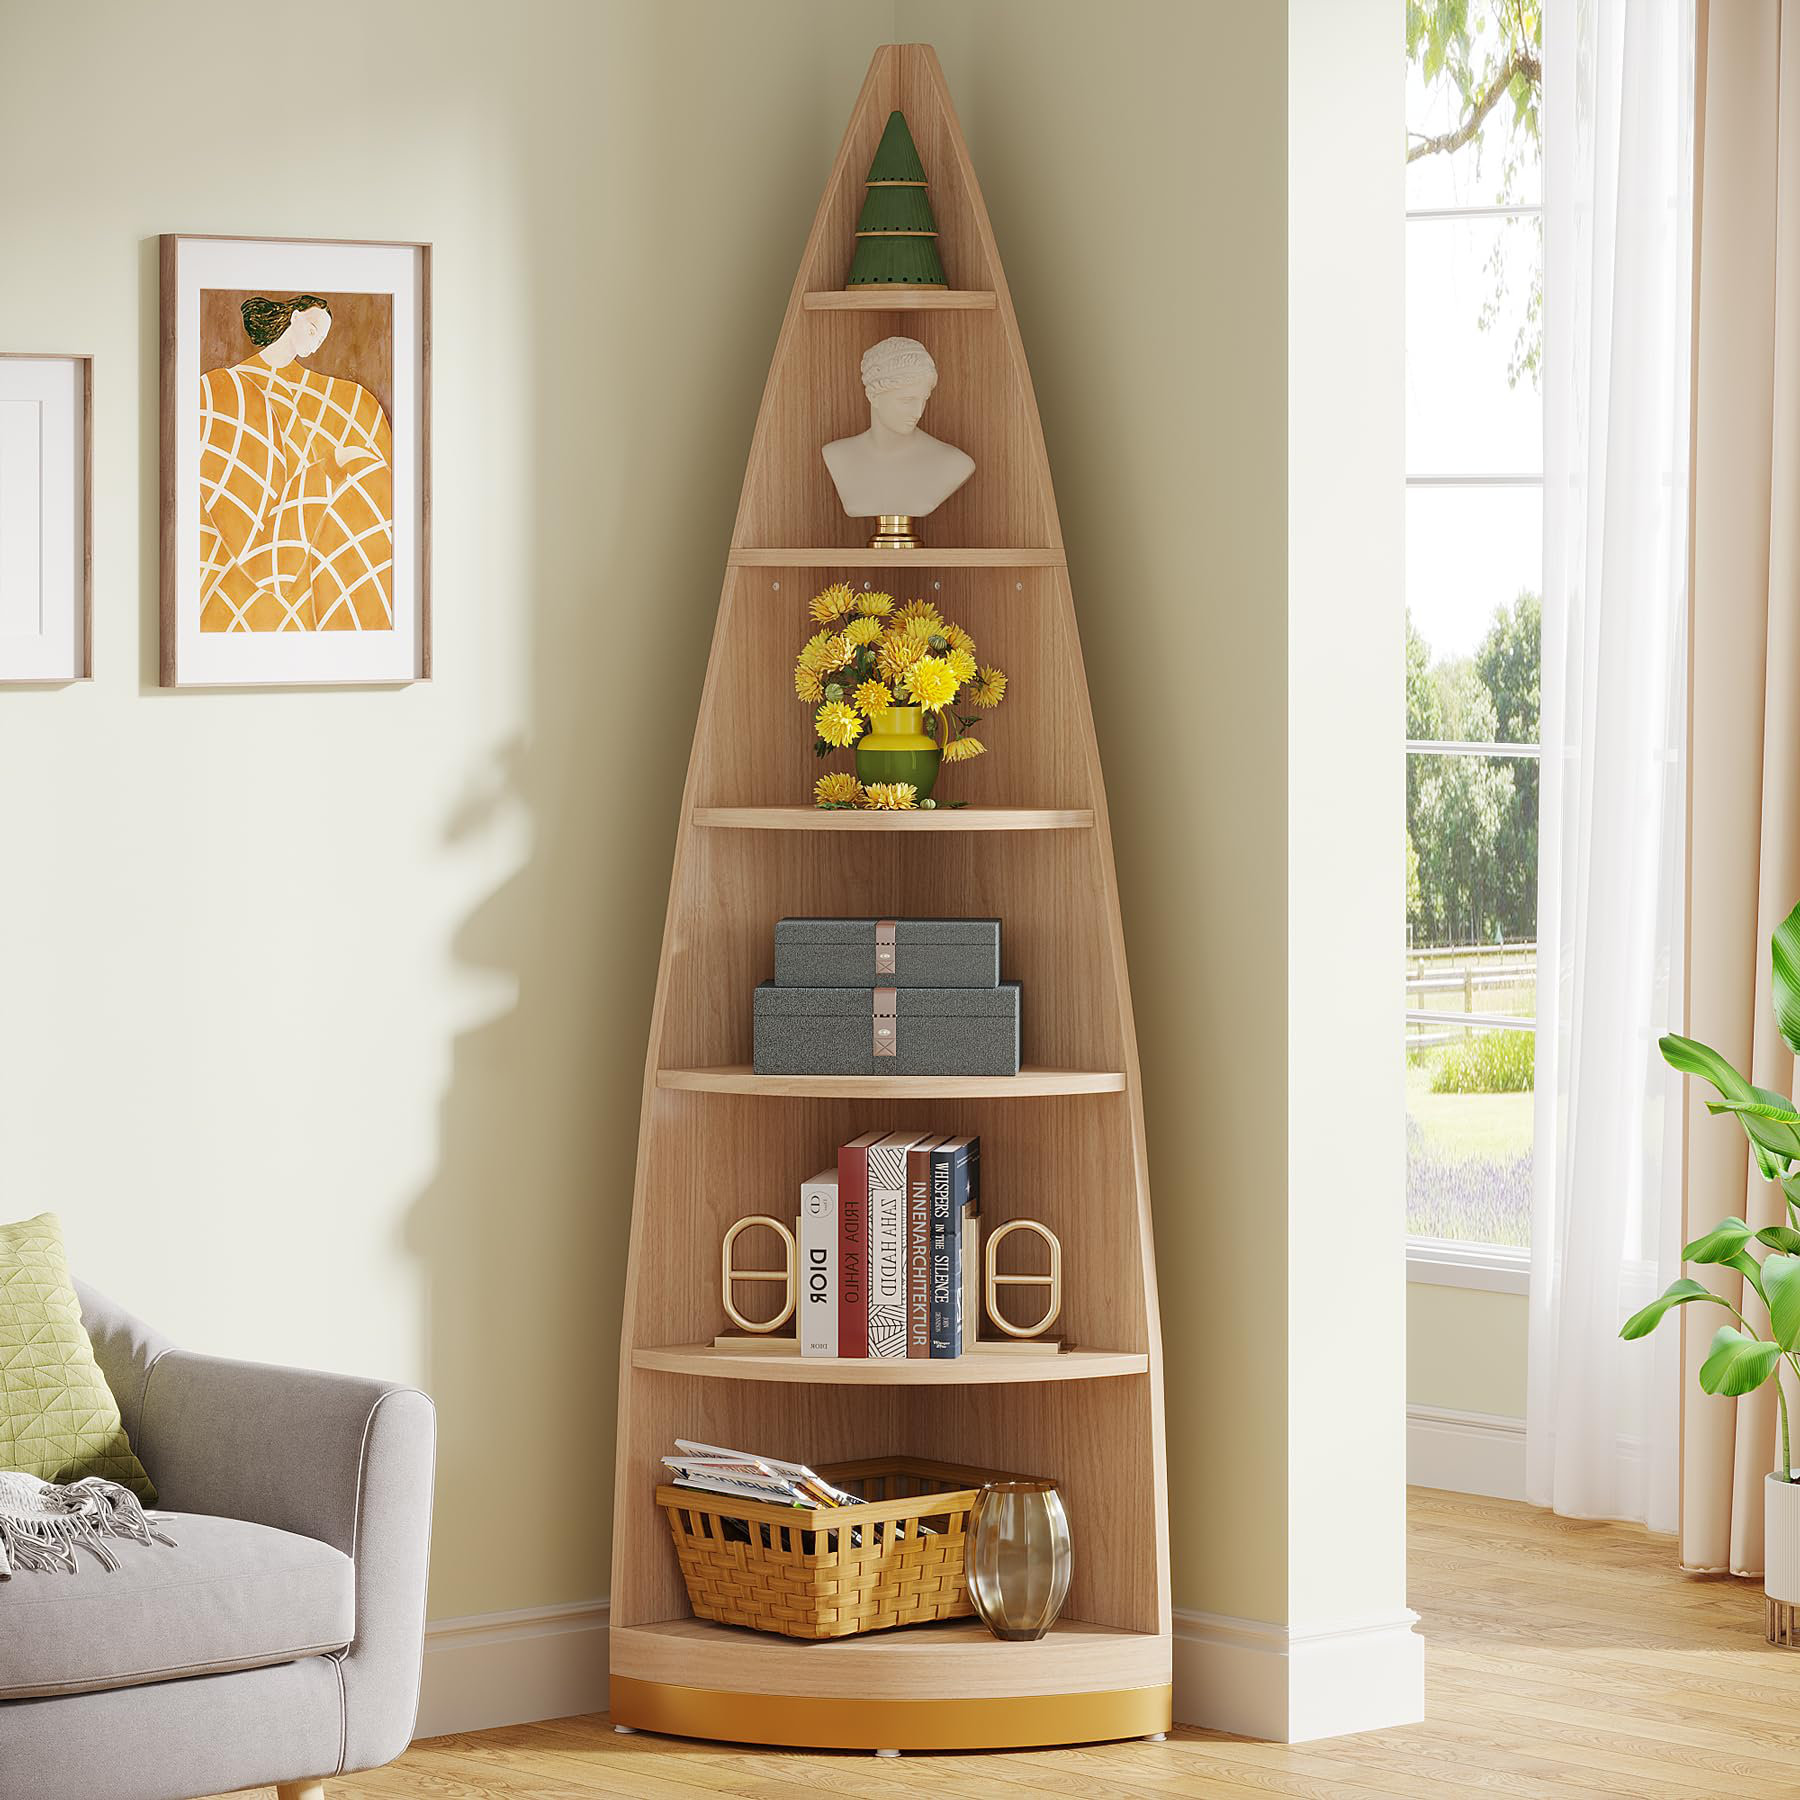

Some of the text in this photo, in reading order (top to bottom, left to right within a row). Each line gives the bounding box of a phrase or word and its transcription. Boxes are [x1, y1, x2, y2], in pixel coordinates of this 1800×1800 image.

[911, 1181, 928, 1346] INNENARCHITEKTUR
[934, 1162, 950, 1304] WHISPERS IN THE SILENCE
